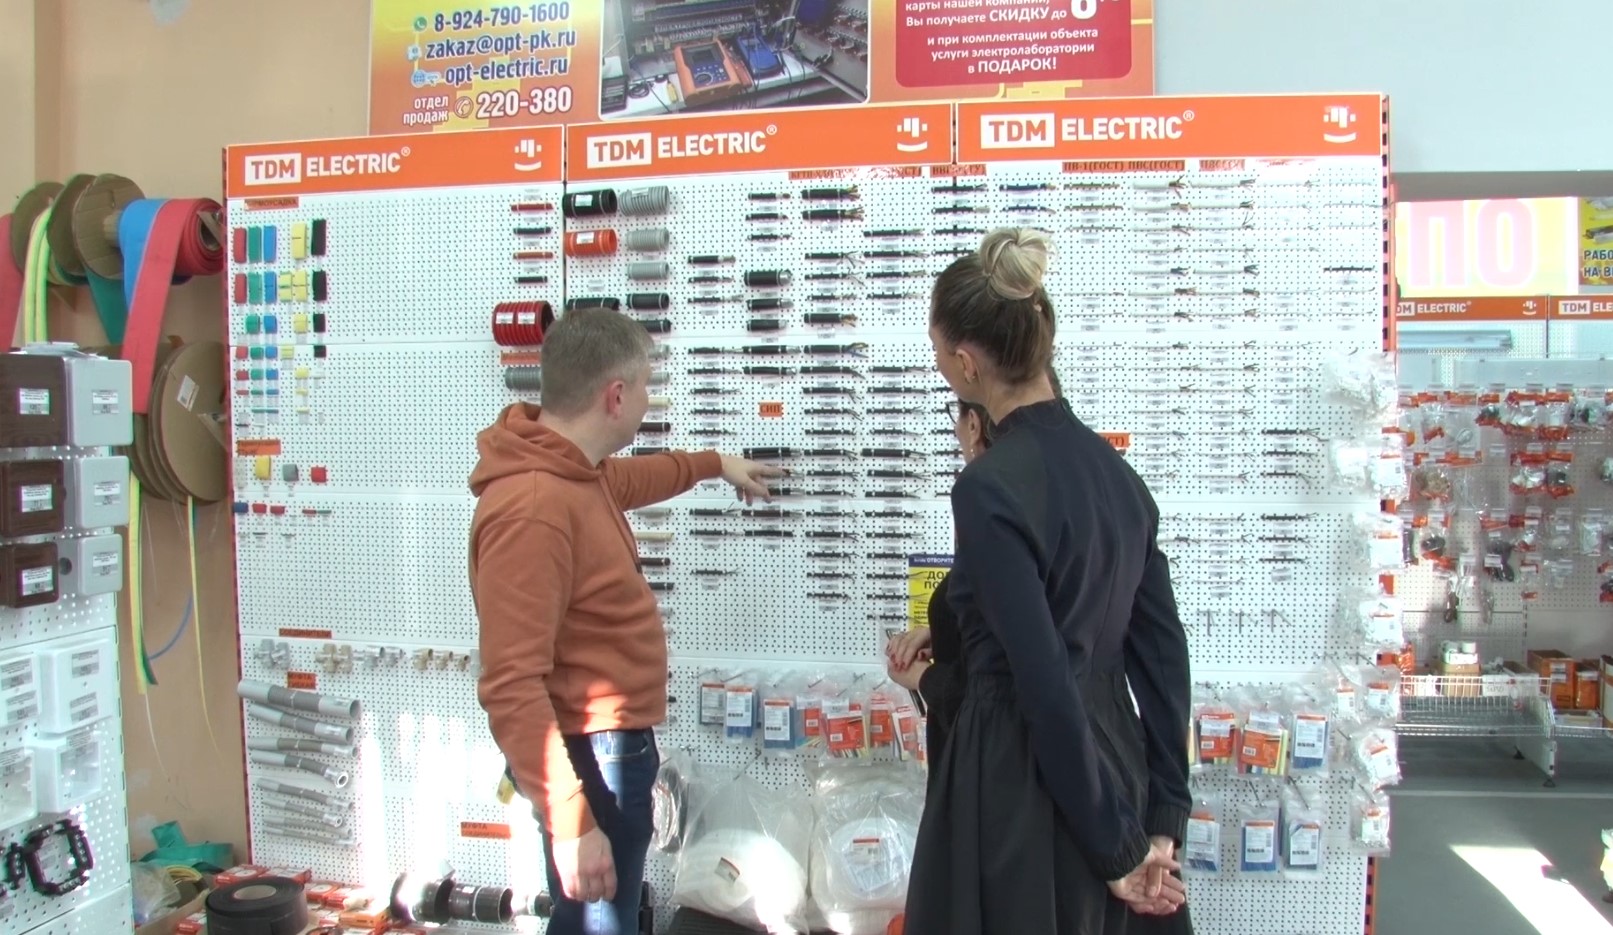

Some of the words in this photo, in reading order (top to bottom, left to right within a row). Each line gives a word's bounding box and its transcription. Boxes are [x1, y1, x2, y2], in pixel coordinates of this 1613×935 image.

[905, 1, 941, 12] карты
[944, 0, 983, 9] нашей
[434, 2, 570, 32] 8-924-790-1600
[906, 17, 923, 27] Вы
[926, 14, 986, 26] получаете
[989, 6, 1050, 23] СКИДКУ
[1051, 10, 1067, 21] до
[426, 30, 576, 59] zakaz@opt-pk.ru
[927, 37, 935, 46] и
[937, 35, 959, 47] при
[962, 31, 1047, 44] комплектации
[1050, 27, 1098, 40] объекта
[931, 48, 968, 61] услуги
[971, 42, 1095, 58] электролаборатории
[445, 58, 568, 86] opt-electric.ru
[968, 65, 975, 74] в
[978, 57, 1057, 74] ПОДАРОК!
[414, 95, 449, 111] отдел
[475, 86, 573, 119] 220-380
[403, 110, 449, 126] продаж
[988, 119, 1047, 142] TDM
[1062, 116, 1182, 140] ELECTRIC
[593, 138, 645, 162] TDM
[657, 131, 766, 158] ELECTRIC
[251, 158, 296, 180] TDM
[306, 152, 401, 177] ELECTRIC
[1584, 267, 1599, 277] НА
[1417, 303, 1467, 313] ELECTRIC
[1562, 302, 1588, 313] TDM
